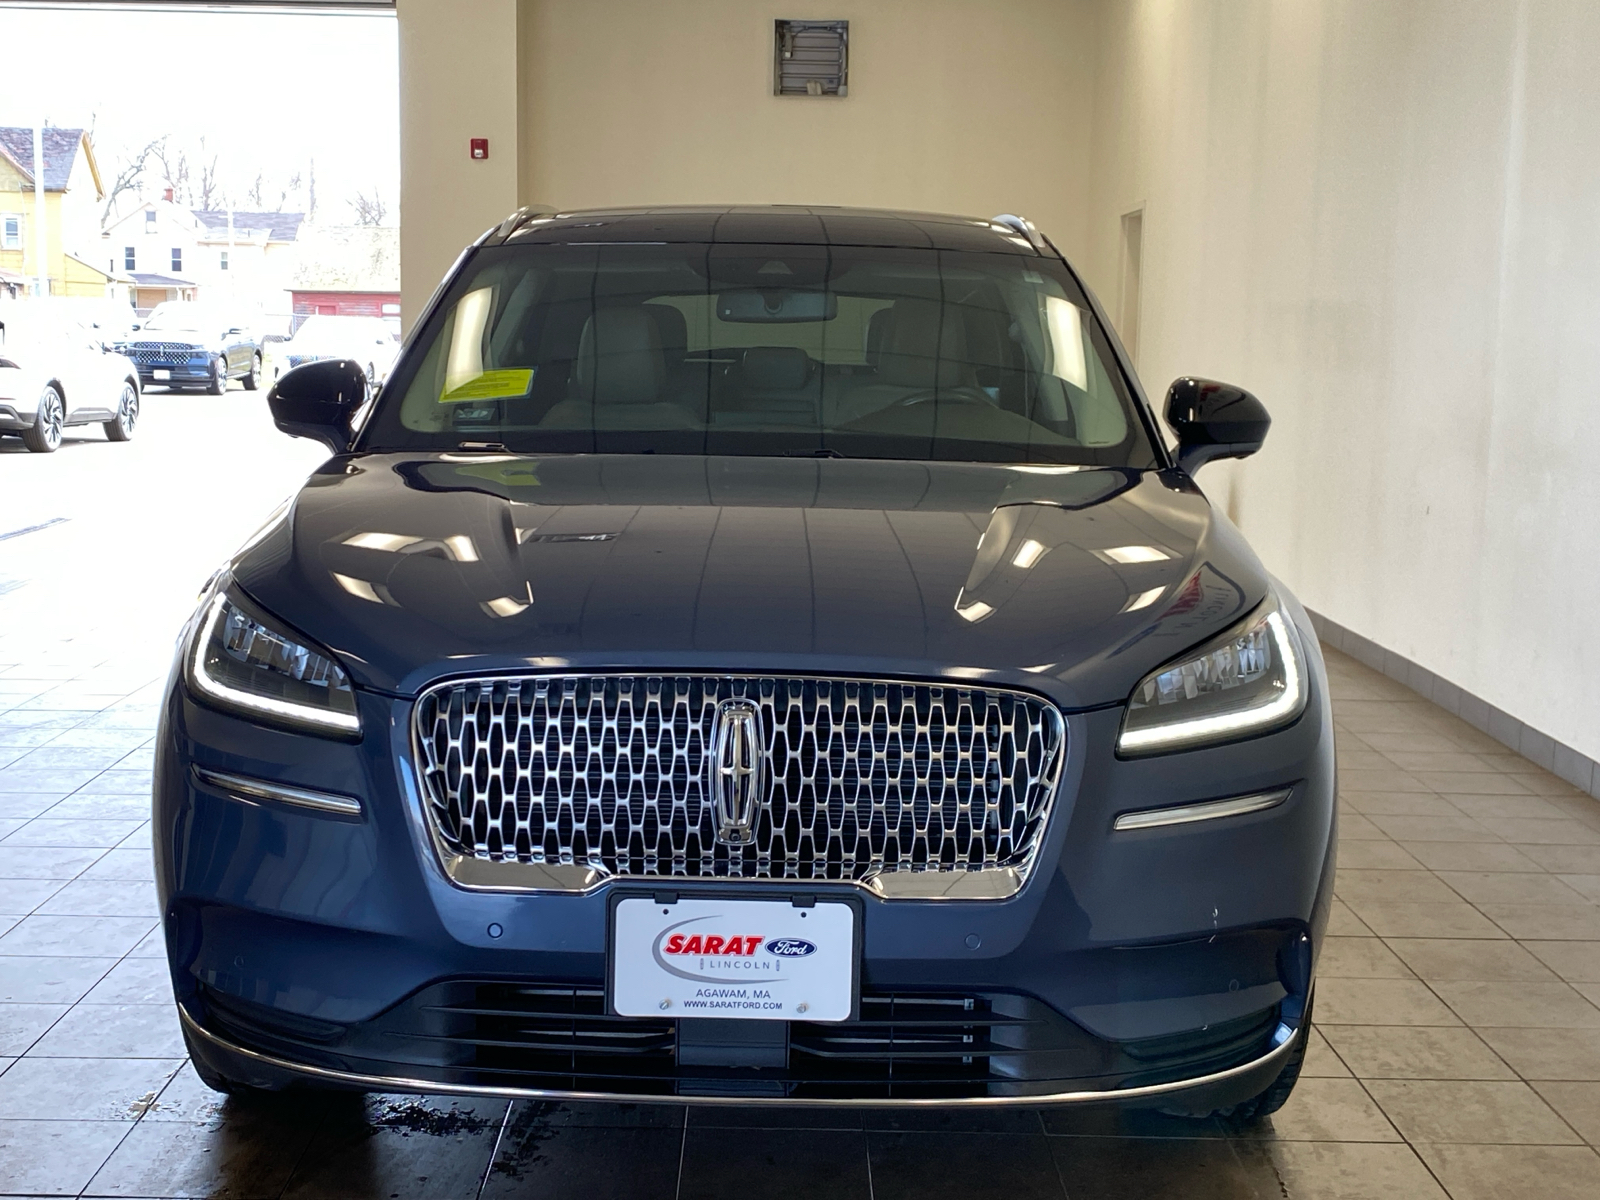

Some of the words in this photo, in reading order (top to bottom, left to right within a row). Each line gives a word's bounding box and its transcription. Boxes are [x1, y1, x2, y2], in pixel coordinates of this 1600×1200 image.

[664, 933, 765, 957] SARAT
[773, 940, 809, 956] Ford
[709, 961, 770, 970] LINCOLN
[696, 989, 750, 999] AGAWAM,
[754, 990, 771, 999] MA
[684, 1001, 783, 1010] WWW.SARATFORD.COM
